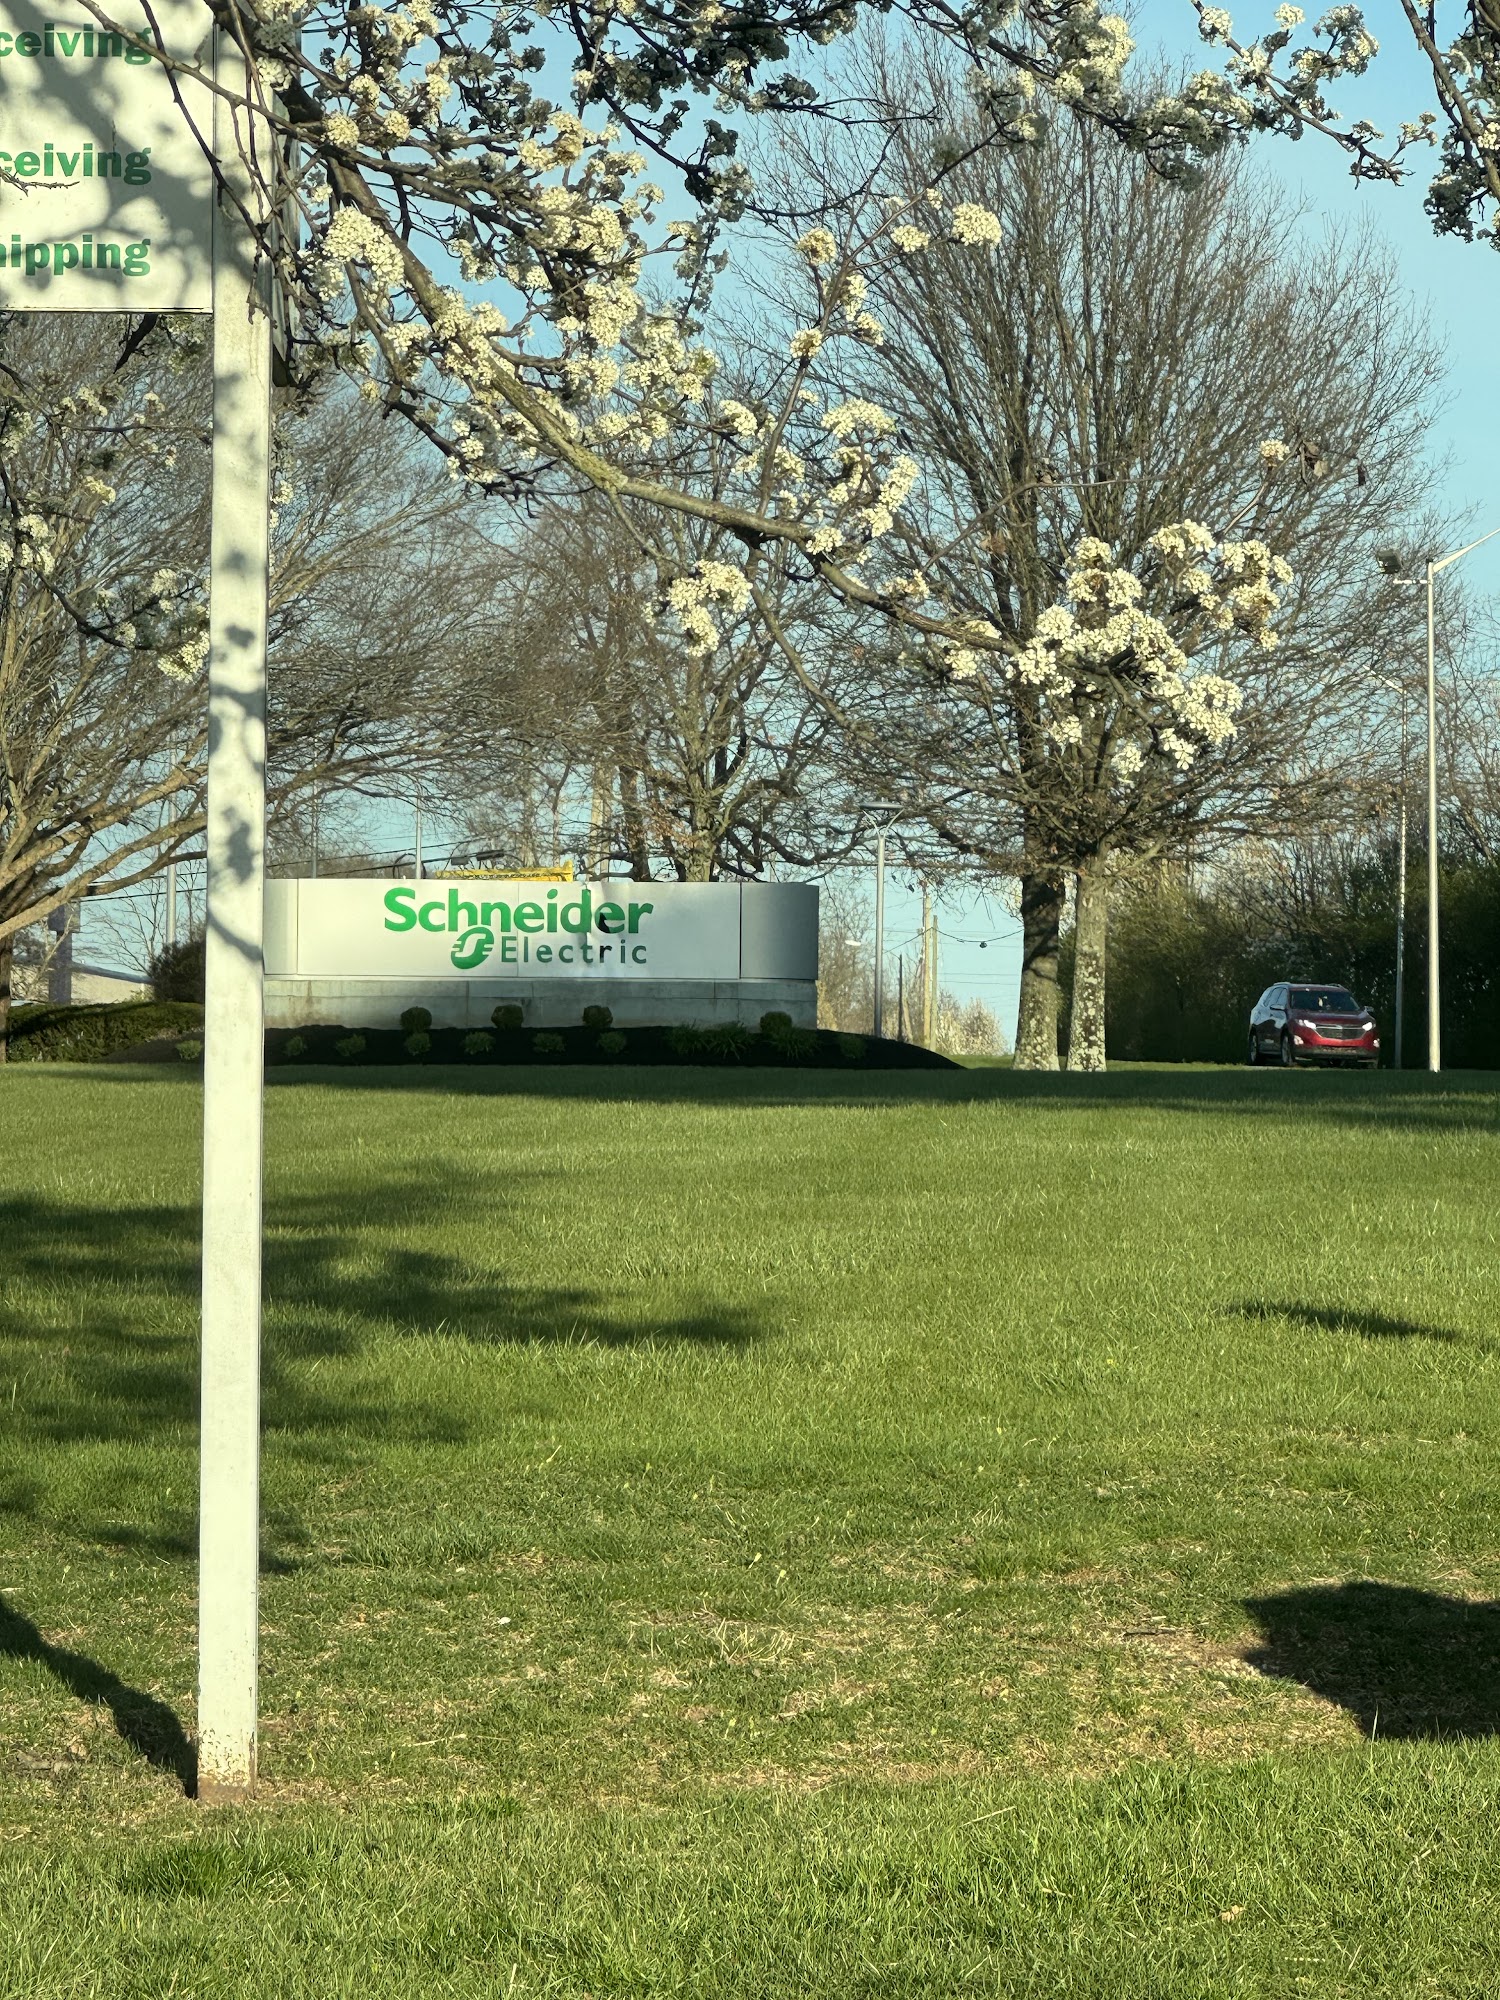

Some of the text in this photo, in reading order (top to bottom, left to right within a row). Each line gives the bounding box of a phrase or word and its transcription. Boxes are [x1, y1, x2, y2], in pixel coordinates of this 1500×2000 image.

[0, 234, 151, 276] ipping
[383, 887, 654, 934] Schneider
[501, 936, 647, 964] Electric
